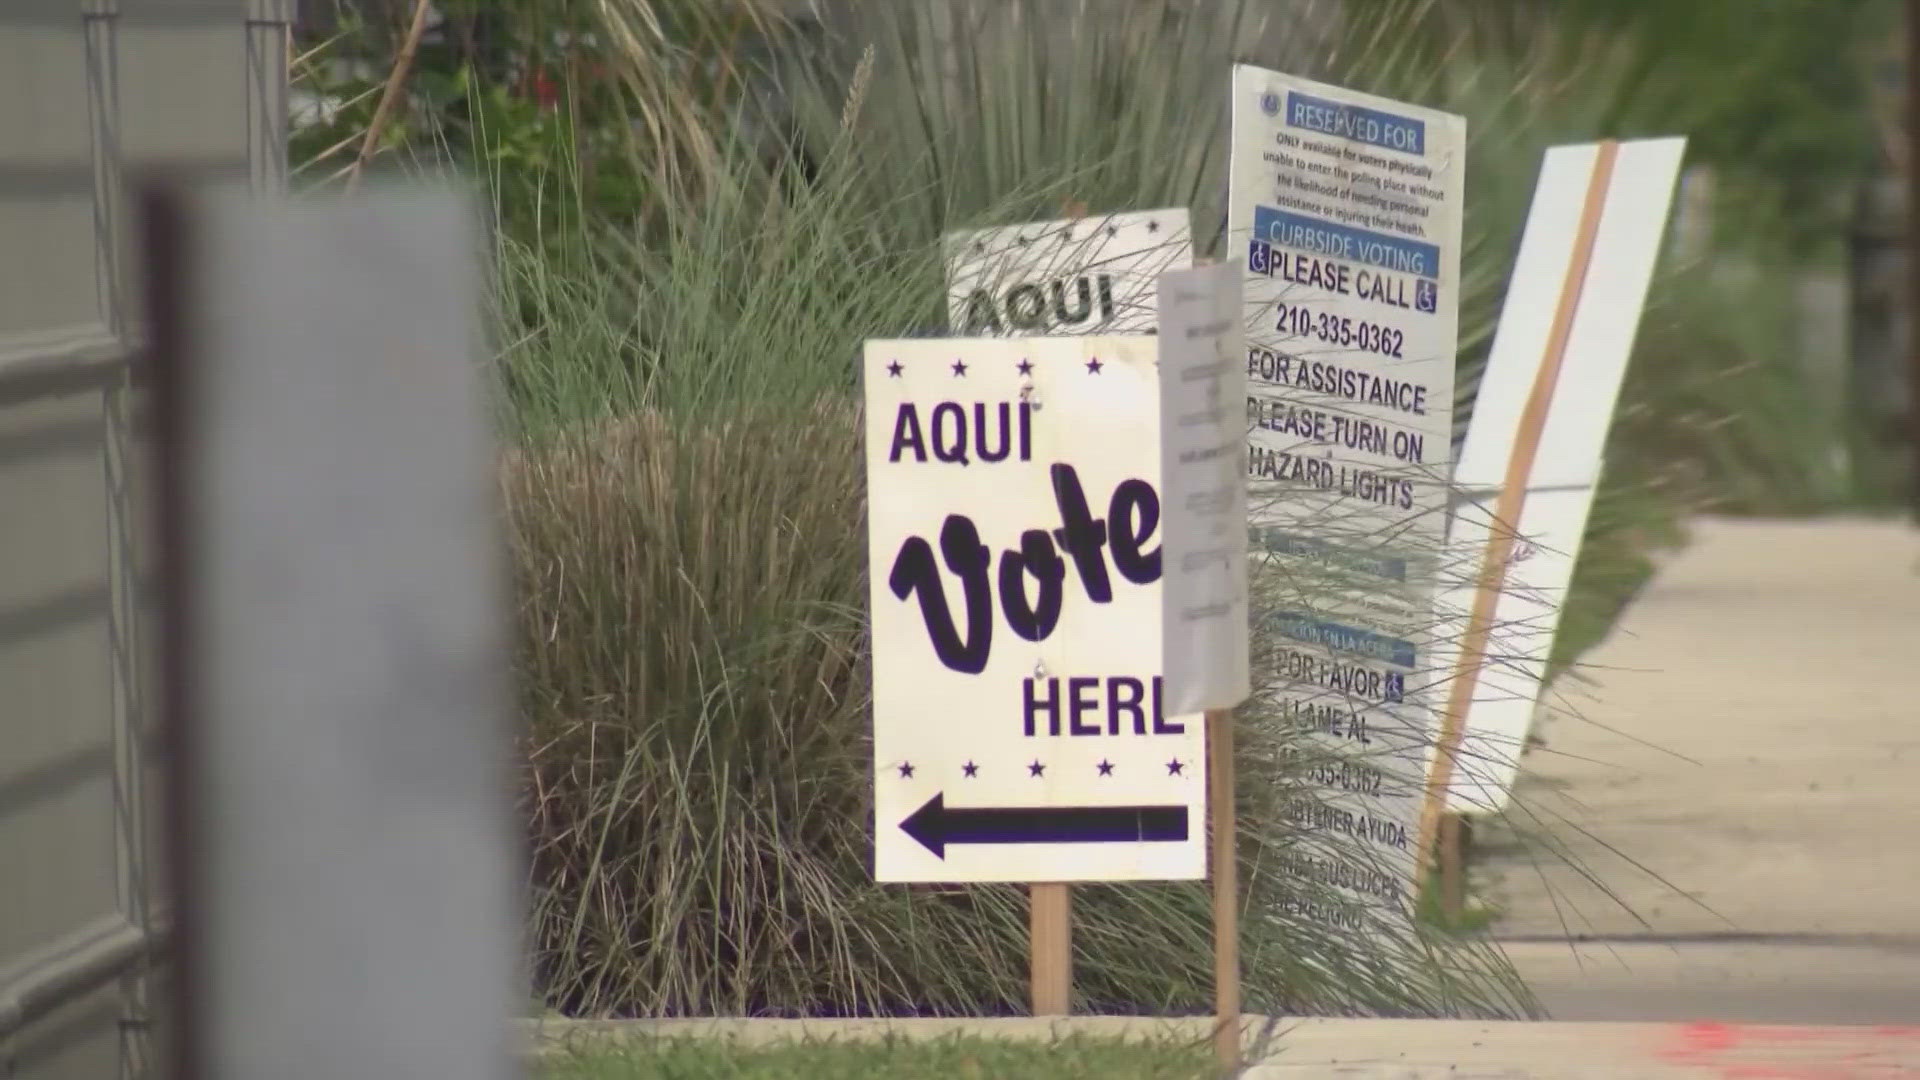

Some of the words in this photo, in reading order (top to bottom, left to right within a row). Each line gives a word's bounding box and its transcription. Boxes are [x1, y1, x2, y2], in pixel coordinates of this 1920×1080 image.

[1276, 132, 1300, 148] ONLY
[1302, 141, 1341, 158] available
[1343, 147, 1356, 161] for
[1359, 154, 1387, 169] voters
[1389, 160, 1432, 181] physically
[1384, 123, 1417, 151] FOR
[1263, 151, 1294, 168] unable
[1296, 158, 1306, 170] to
[1307, 162, 1331, 174] enter
[1334, 166, 1349, 179] the
[1351, 171, 1381, 190] polling
[1383, 177, 1406, 193] place
[1409, 185, 1444, 201] without
[1277, 173, 1293, 188] the
[1294, 175, 1338, 198] likelihood
[1340, 188, 1350, 200] of
[1351, 192, 1388, 211] needing
[1389, 201, 1429, 218] personal
[1276, 195, 1321, 214] assistance
[1323, 206, 1333, 217] or
[1335, 206, 1370, 228] injuring
[1372, 215, 1393, 229] their
[1269, 220, 1352, 258] CURBSIDE
[1358, 242, 1424, 274] VOTING
[1270, 250, 1349, 295] PLEASE
[1356, 270, 1410, 309] CALL
[1276, 303, 1404, 359] 210-335-0362
[1249, 350, 1290, 384] FOR
[1296, 359, 1427, 416] ASSISTANCE
[1247, 396, 1327, 442] PLEASE
[1332, 415, 1387, 455] TURN
[1393, 431, 1424, 464] ON
[1249, 446, 1334, 490] HAZARD
[1340, 466, 1413, 510] LIGHTS
[889, 463, 1163, 675] Vote
[1356, 815, 1407, 850] AYUDA
